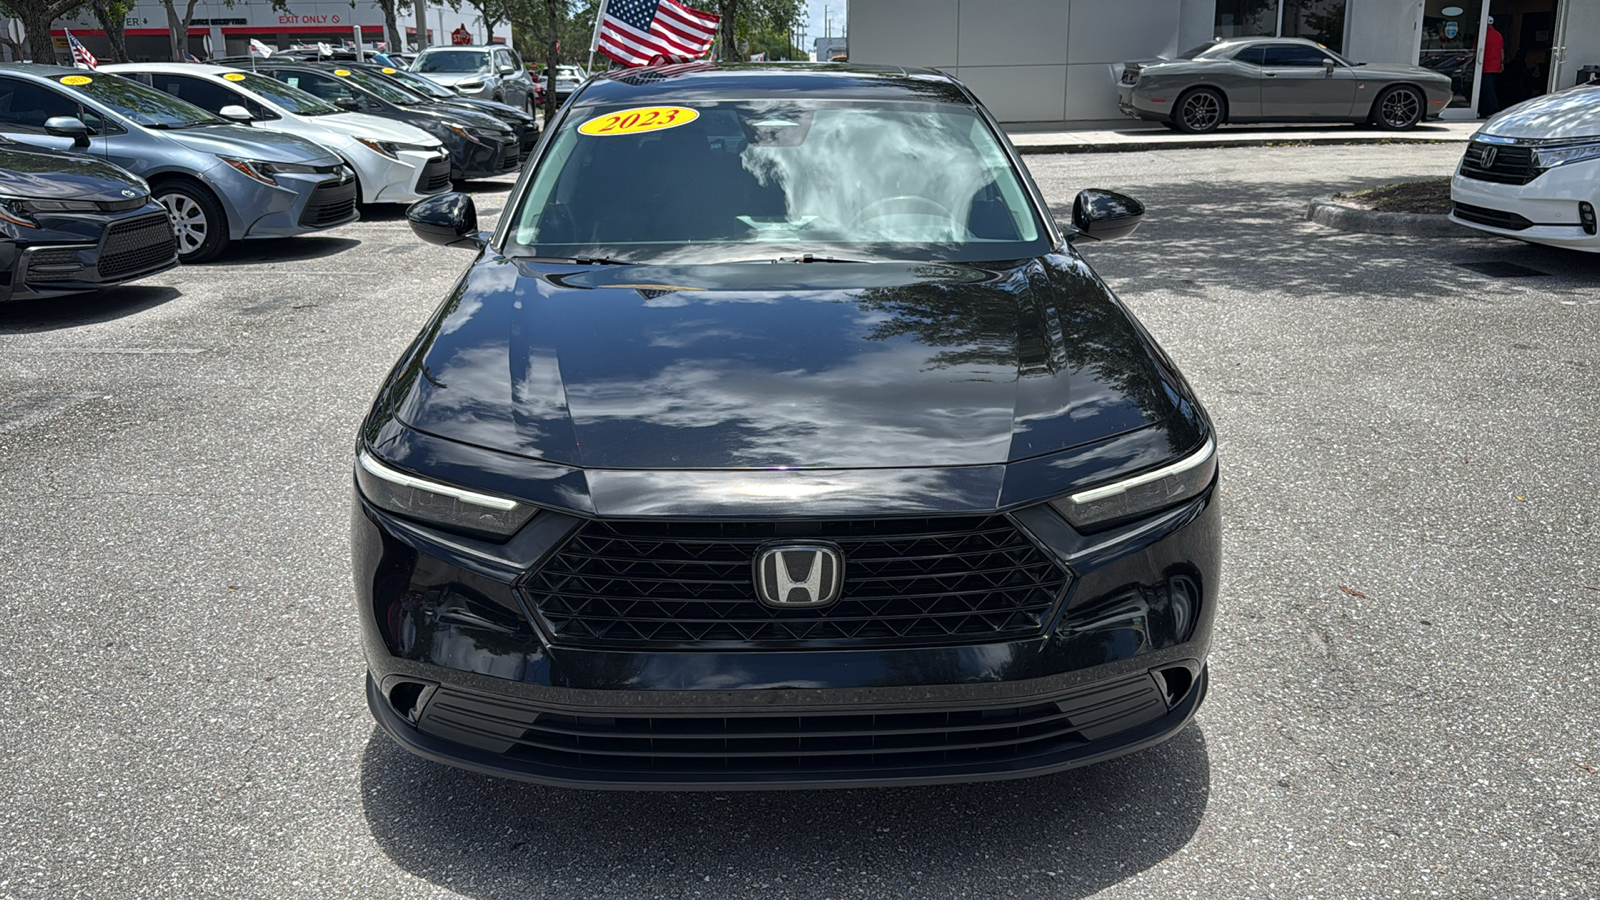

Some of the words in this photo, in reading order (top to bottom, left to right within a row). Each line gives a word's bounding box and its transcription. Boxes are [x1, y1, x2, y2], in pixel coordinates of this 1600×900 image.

[279, 15, 299, 24] EXIT
[302, 15, 328, 24] ONLY
[597, 109, 680, 133] 2023
